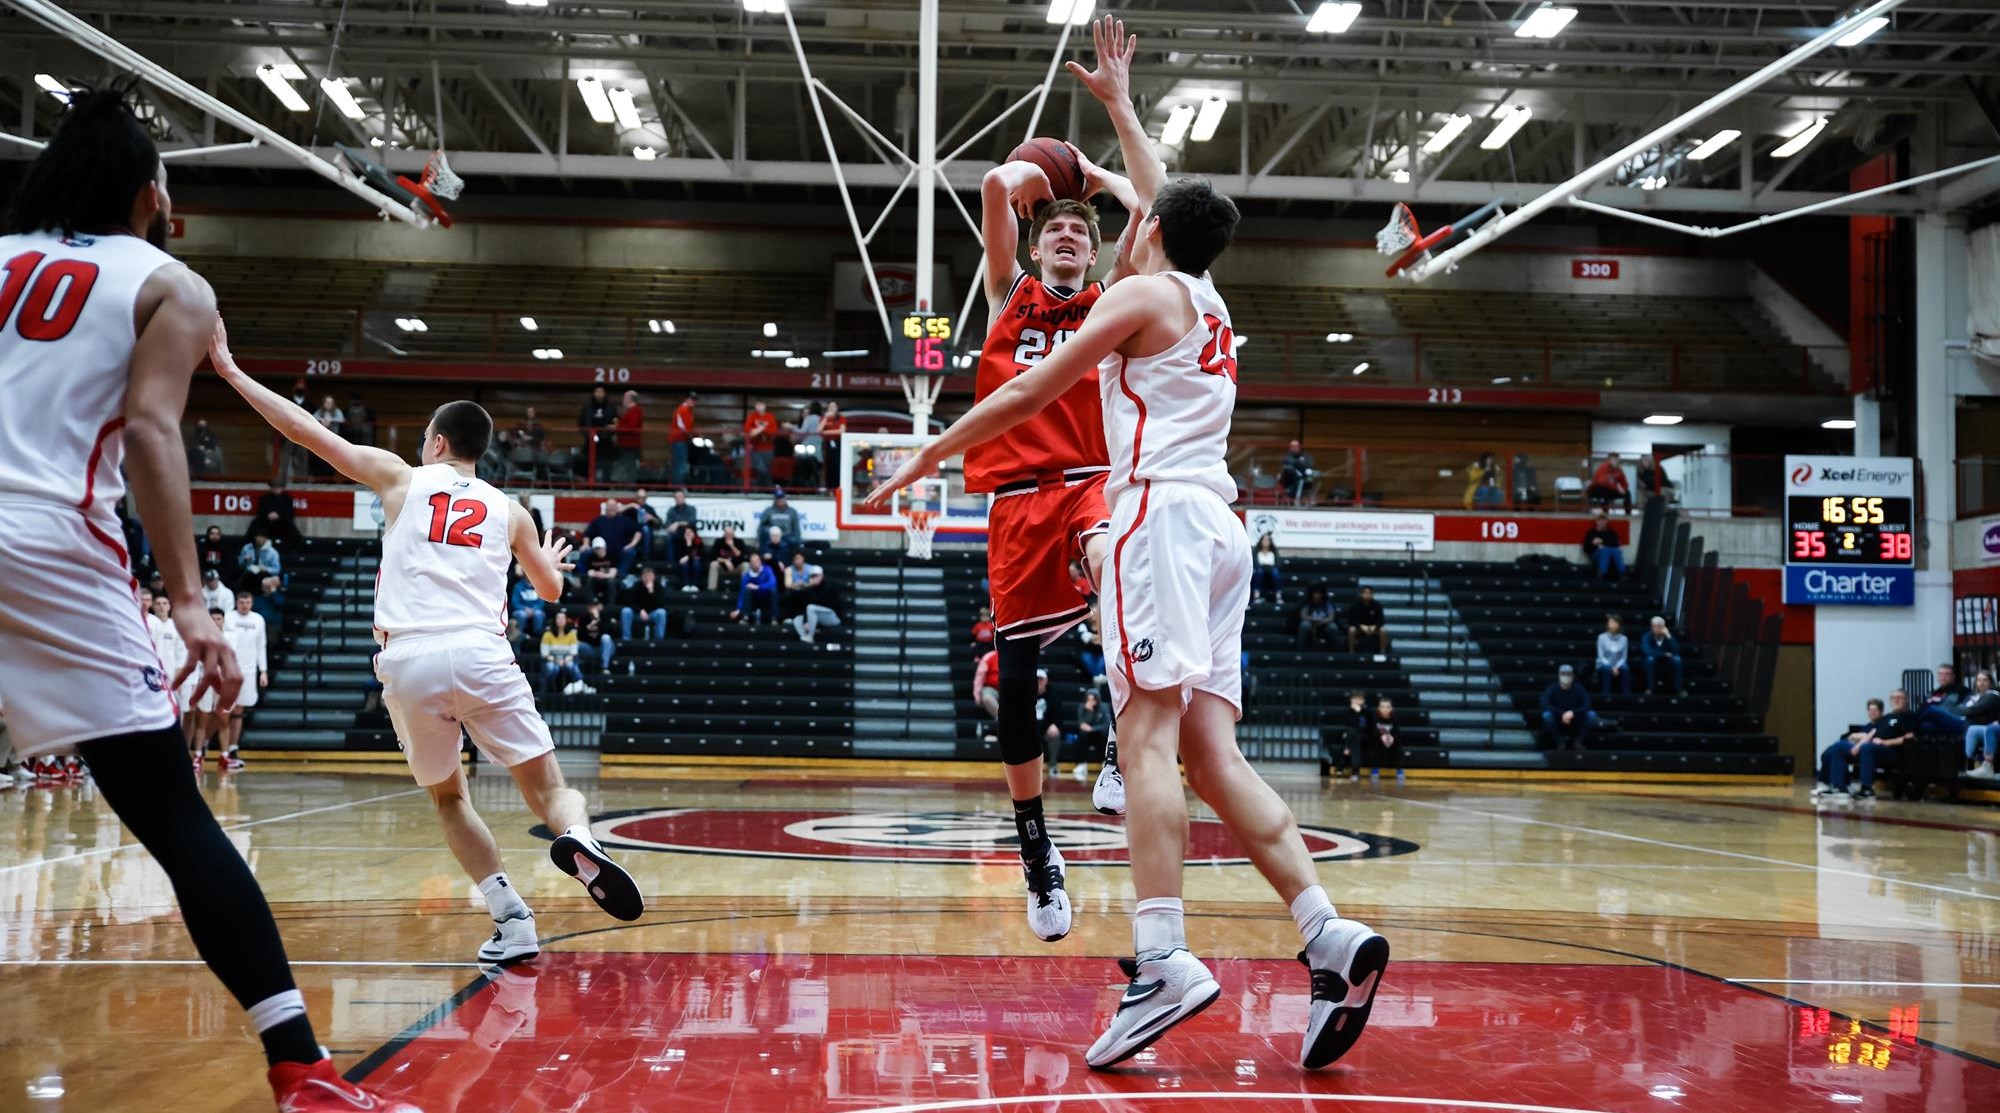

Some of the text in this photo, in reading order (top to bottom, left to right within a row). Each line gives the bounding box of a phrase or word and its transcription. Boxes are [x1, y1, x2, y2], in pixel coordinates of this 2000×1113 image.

[1581, 263, 1610, 276] 300
[0, 250, 99, 341] 10
[915, 337, 944, 370] 16
[306, 360, 342, 375] 209
[595, 367, 630, 383] 210
[811, 373, 842, 388] 211
[1428, 388, 1461, 403] 213
[1820, 468, 1905, 485] Xcel Energy
[213, 494, 252, 511] 106
[428, 491, 487, 548] 12
[1285, 520, 1298, 528] We
[1302, 520, 1331, 529] deliver
[1335, 521, 1378, 532] packages
[1381, 522, 1391, 530] to
[1794, 523, 1820, 531] HOME
[1481, 521, 1519, 539] 109
[1795, 531, 1826, 558] 35
[1843, 532, 1855, 549] 2
[1880, 532, 1911, 559] 38
[1804, 570, 1895, 594] Charter
